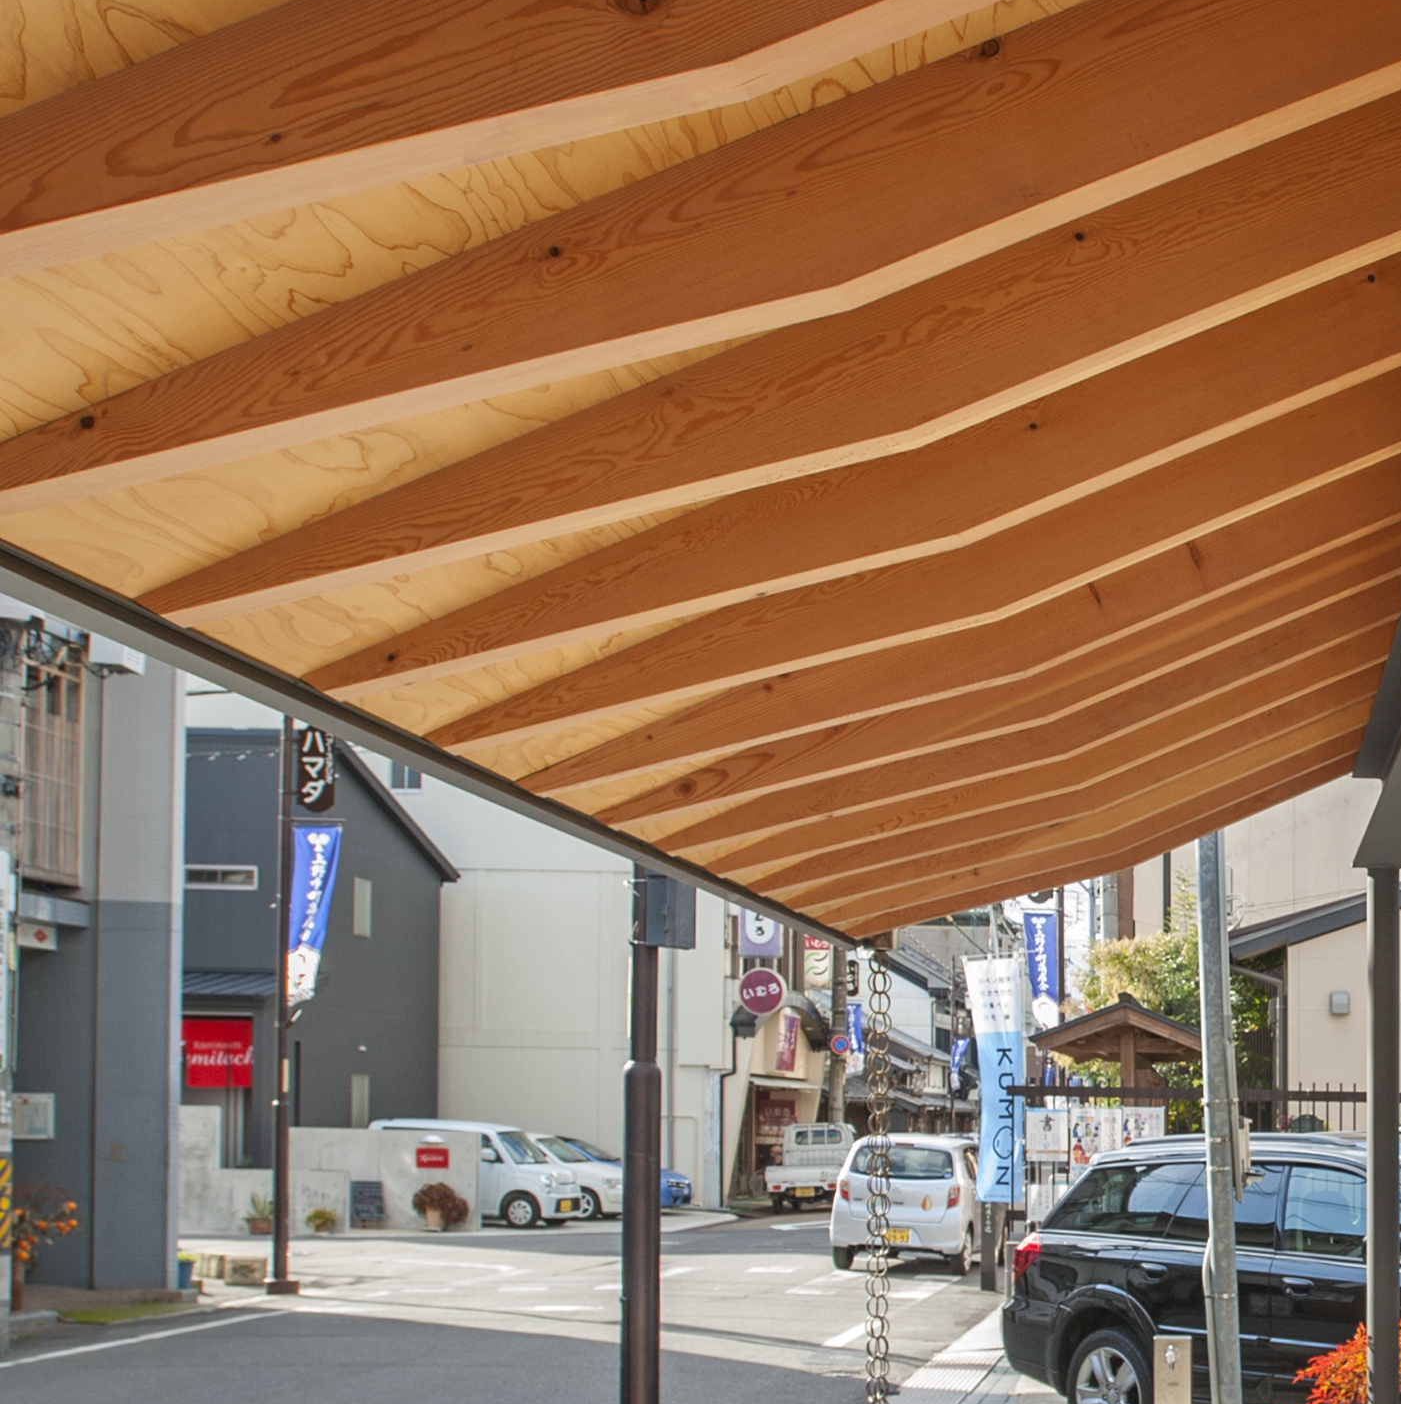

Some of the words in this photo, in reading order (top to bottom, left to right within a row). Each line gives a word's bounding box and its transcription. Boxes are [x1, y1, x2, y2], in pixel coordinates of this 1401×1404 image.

[302, 731, 326, 803] ハマダ
[993, 1048, 1014, 1185] KUMON
